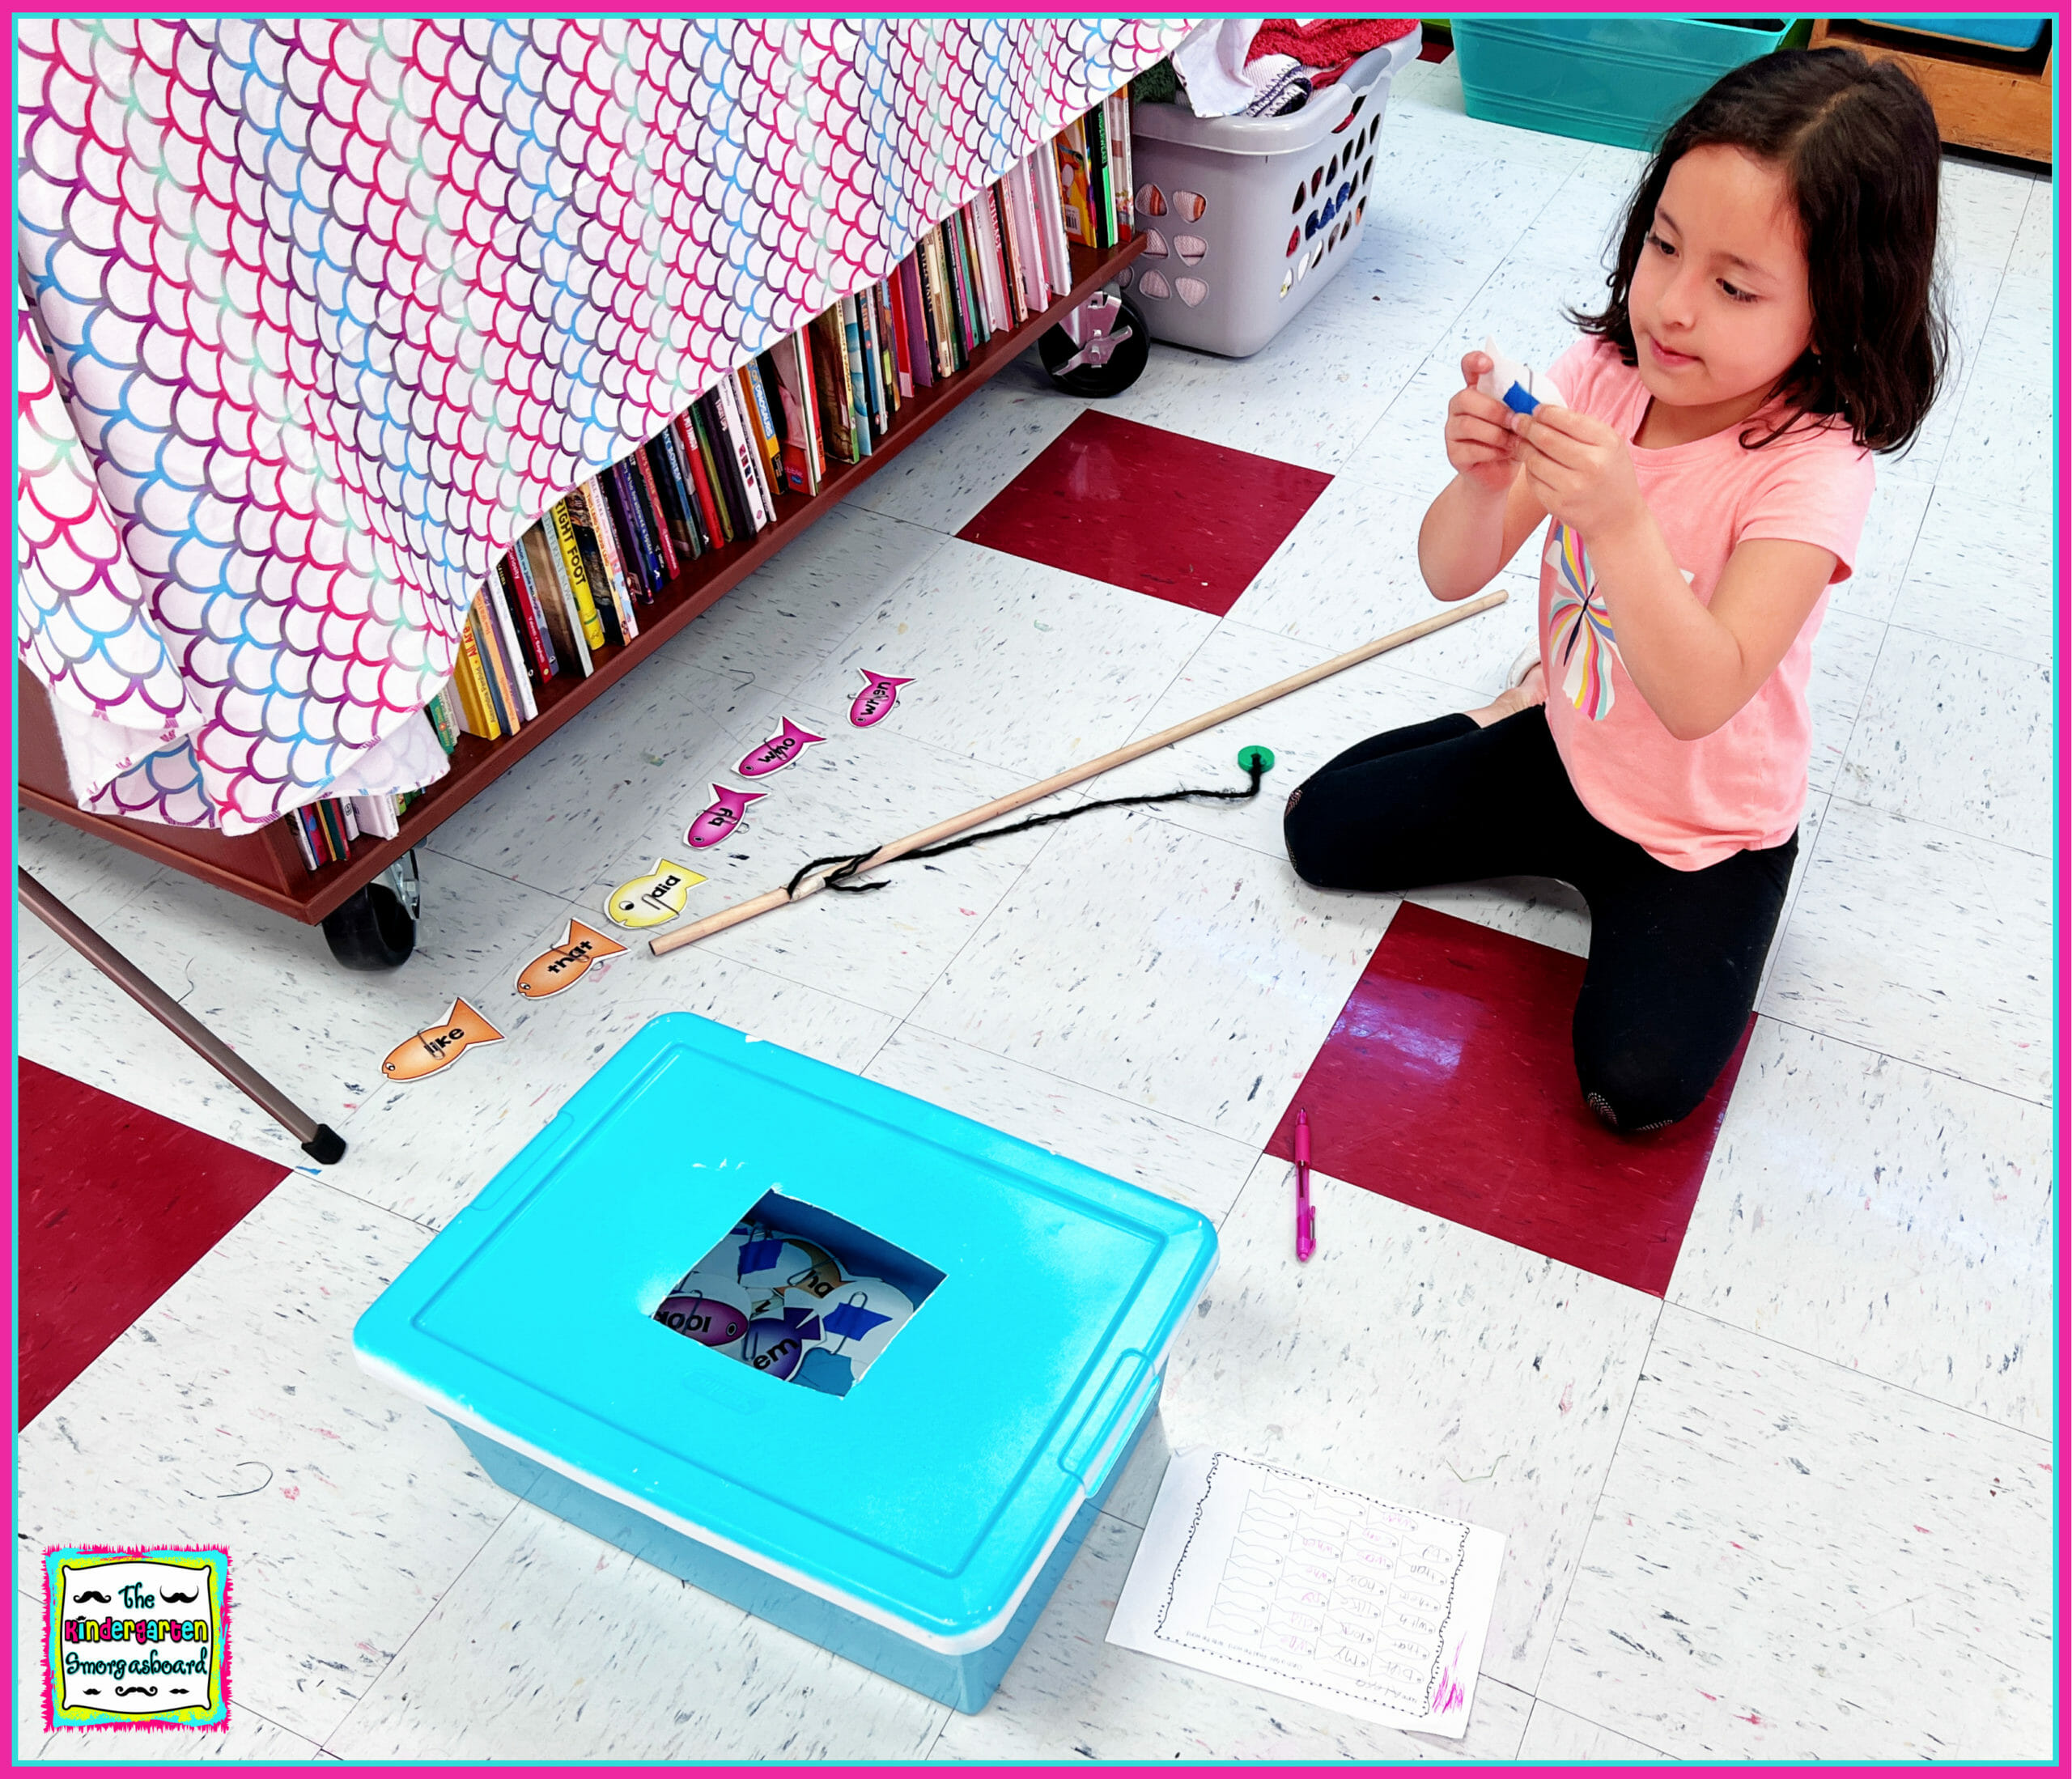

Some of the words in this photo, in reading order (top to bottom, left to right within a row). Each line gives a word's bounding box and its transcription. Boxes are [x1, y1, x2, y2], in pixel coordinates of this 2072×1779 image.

[989, 202, 1002, 253] VILLAGE
[754, 384, 775, 437] DINOSAURS
[543, 517, 564, 572] DIFFERENT
[554, 501, 574, 543] RIGHT
[567, 548, 587, 586] FOOT
[507, 548, 520, 580] Curiosity
[461, 626, 473, 643] Are
[465, 644, 478, 657] All
[861, 682, 891, 716] when
[758, 737, 796, 763] who
[708, 807, 734, 827] by
[651, 874, 681, 899] did
[547, 940, 593, 974] that
[424, 1027, 465, 1054] like
